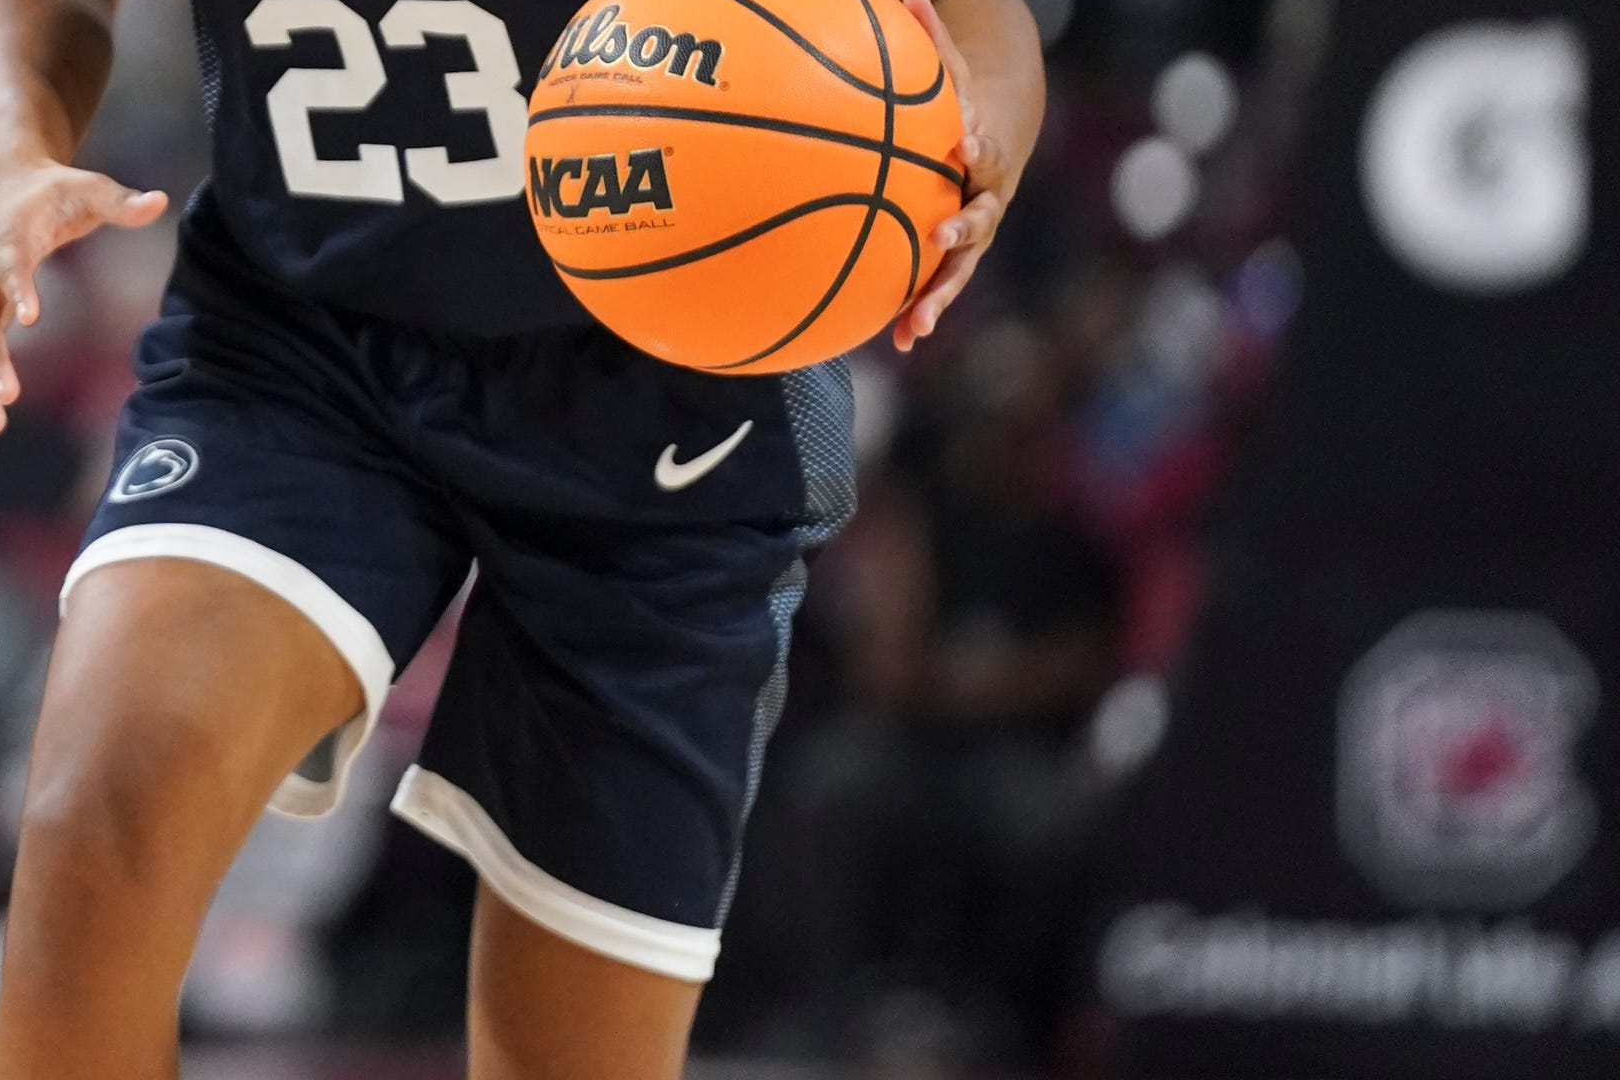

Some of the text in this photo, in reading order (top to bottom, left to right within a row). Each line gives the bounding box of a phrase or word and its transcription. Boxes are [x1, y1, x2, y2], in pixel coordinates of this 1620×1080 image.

[530, 148, 674, 219] NCAA
[575, 223, 620, 236] GAME
[624, 218, 676, 232] BALL
